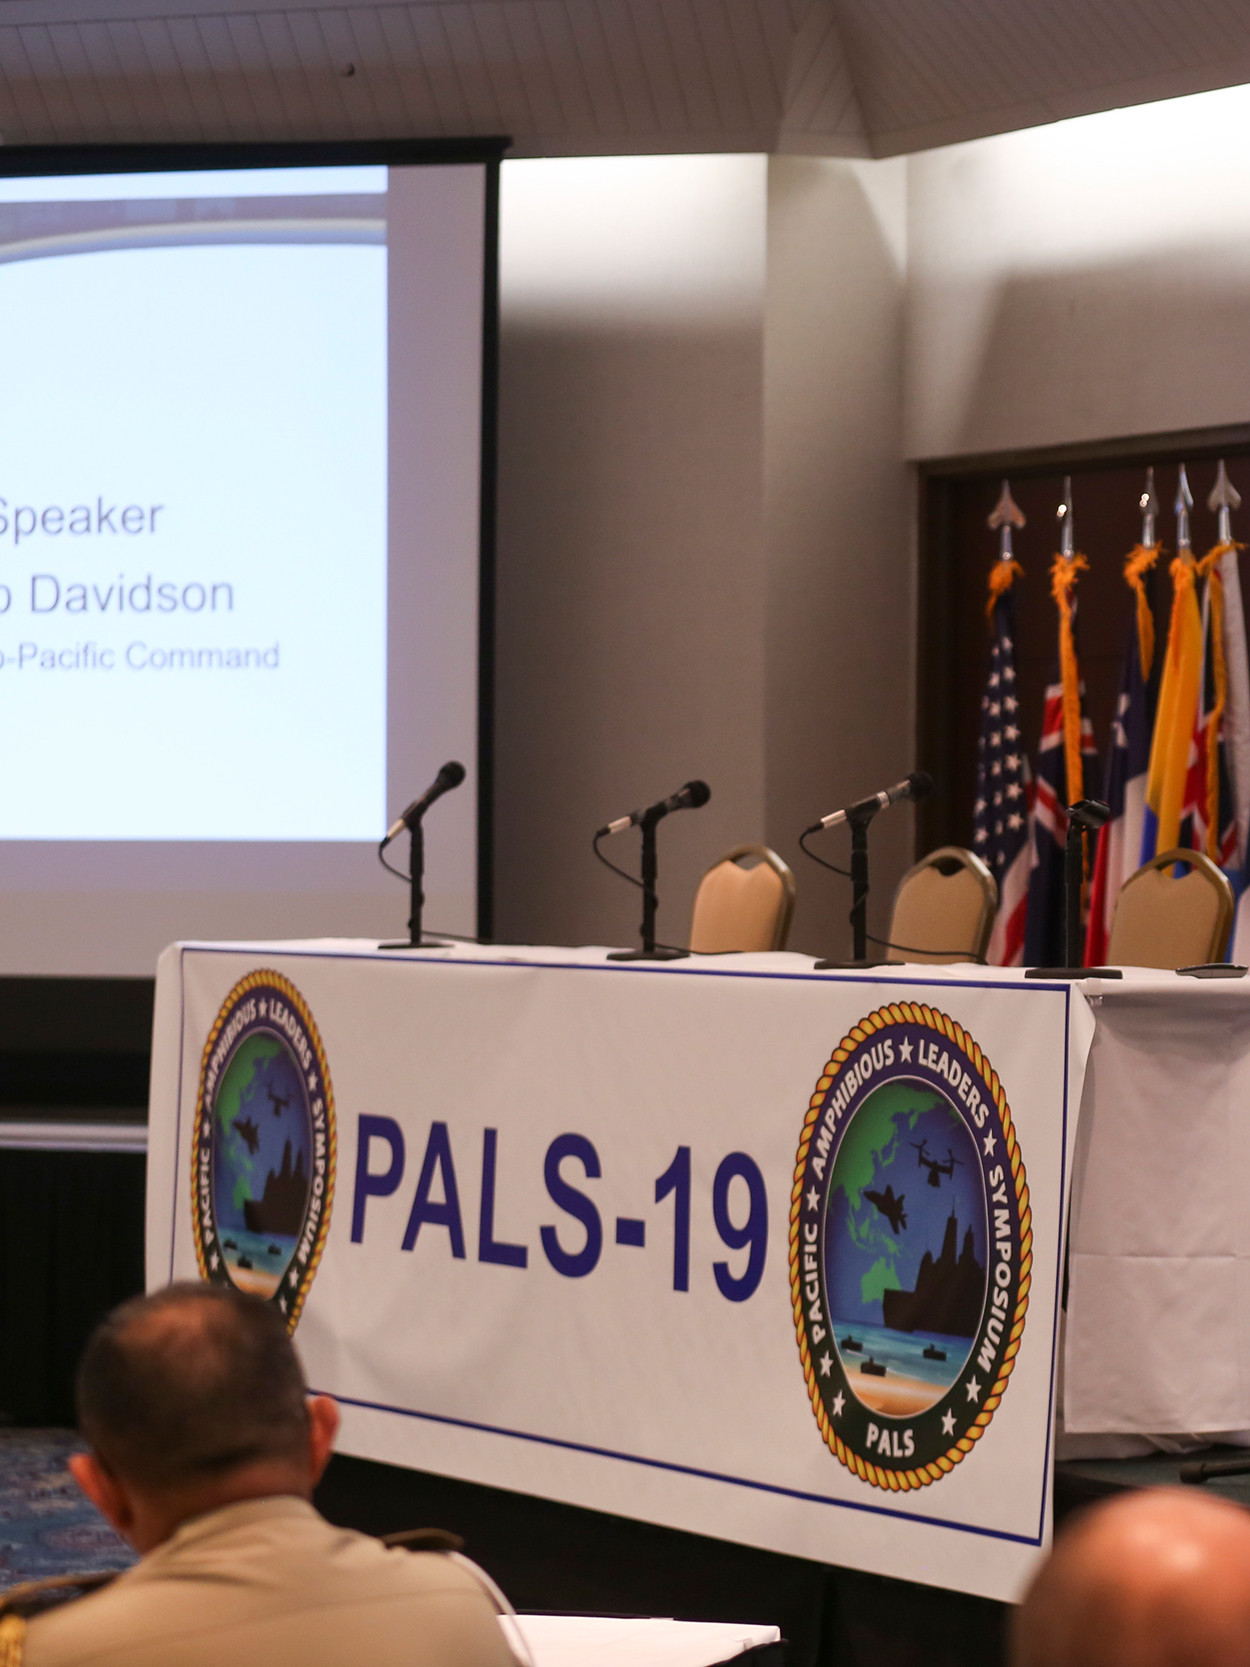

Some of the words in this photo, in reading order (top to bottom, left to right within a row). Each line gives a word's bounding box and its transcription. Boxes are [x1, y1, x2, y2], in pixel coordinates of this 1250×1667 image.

[30, 573, 235, 614] Davidson
[125, 640, 281, 671] Command
[205, 998, 256, 1113] AMPHIBIOUS
[269, 999, 313, 1070] LEADERS
[918, 1038, 990, 1130] LEADERS
[811, 1038, 895, 1179] AMPHIBIOUS
[201, 1147, 214, 1246] PACIFIC
[297, 1097, 326, 1265] SYMPOSIUM
[350, 1112, 769, 1302] PALS-19
[803, 1222, 827, 1344] PACIFIC
[975, 1163, 1012, 1374] SYMPOSIUM
[865, 1421, 916, 1457] PALS
